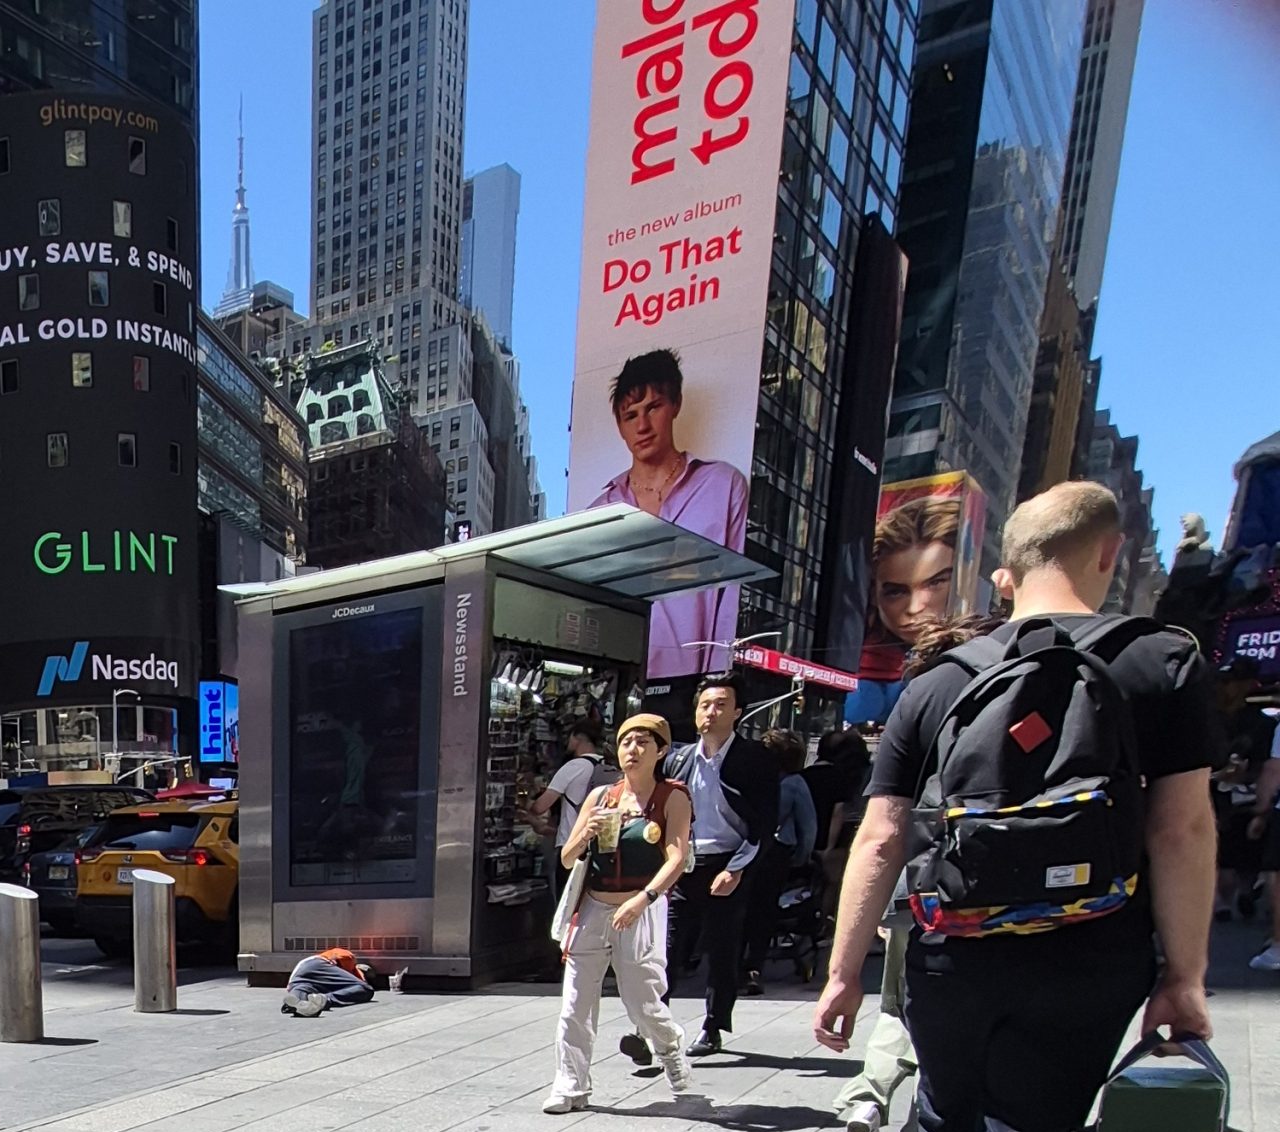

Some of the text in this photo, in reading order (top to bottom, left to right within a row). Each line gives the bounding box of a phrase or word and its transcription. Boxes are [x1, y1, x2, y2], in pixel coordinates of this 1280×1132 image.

[39, 99, 160, 132] glintpay.com
[607, 193, 743, 246] the new album
[45, 241, 120, 266] SAVE,
[128, 246, 142, 267] &
[147, 250, 193, 290] SPEND
[602, 225, 743, 293] Do That
[614, 273, 720, 327] Again
[38, 318, 108, 340] GOLD
[116, 319, 197, 366] INSTANTLY
[33, 530, 178, 575] GLINT
[331, 604, 375, 619] JCDecaux
[453, 593, 471, 697] Newsstand
[92, 653, 178, 688] Nasdaq
[202, 689, 222, 755] hint
